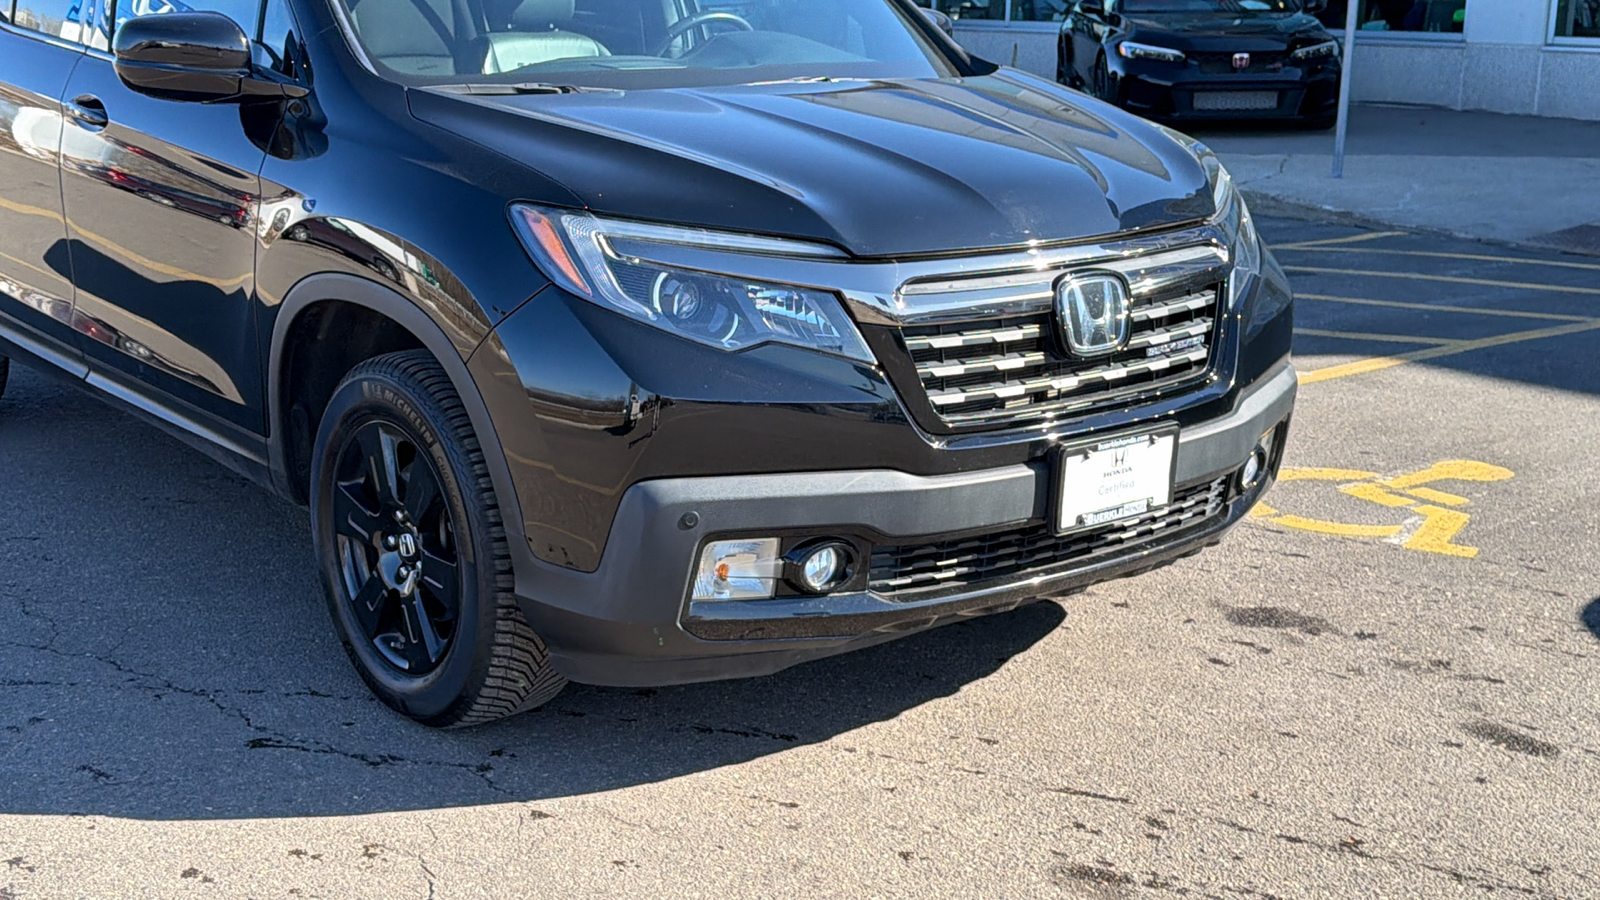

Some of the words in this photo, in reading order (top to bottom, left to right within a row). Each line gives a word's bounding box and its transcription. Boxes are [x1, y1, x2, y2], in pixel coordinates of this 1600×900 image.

[383, 389, 434, 445] MICHELIN
[1103, 466, 1133, 478] HONDA
[1098, 480, 1135, 495] Certified
